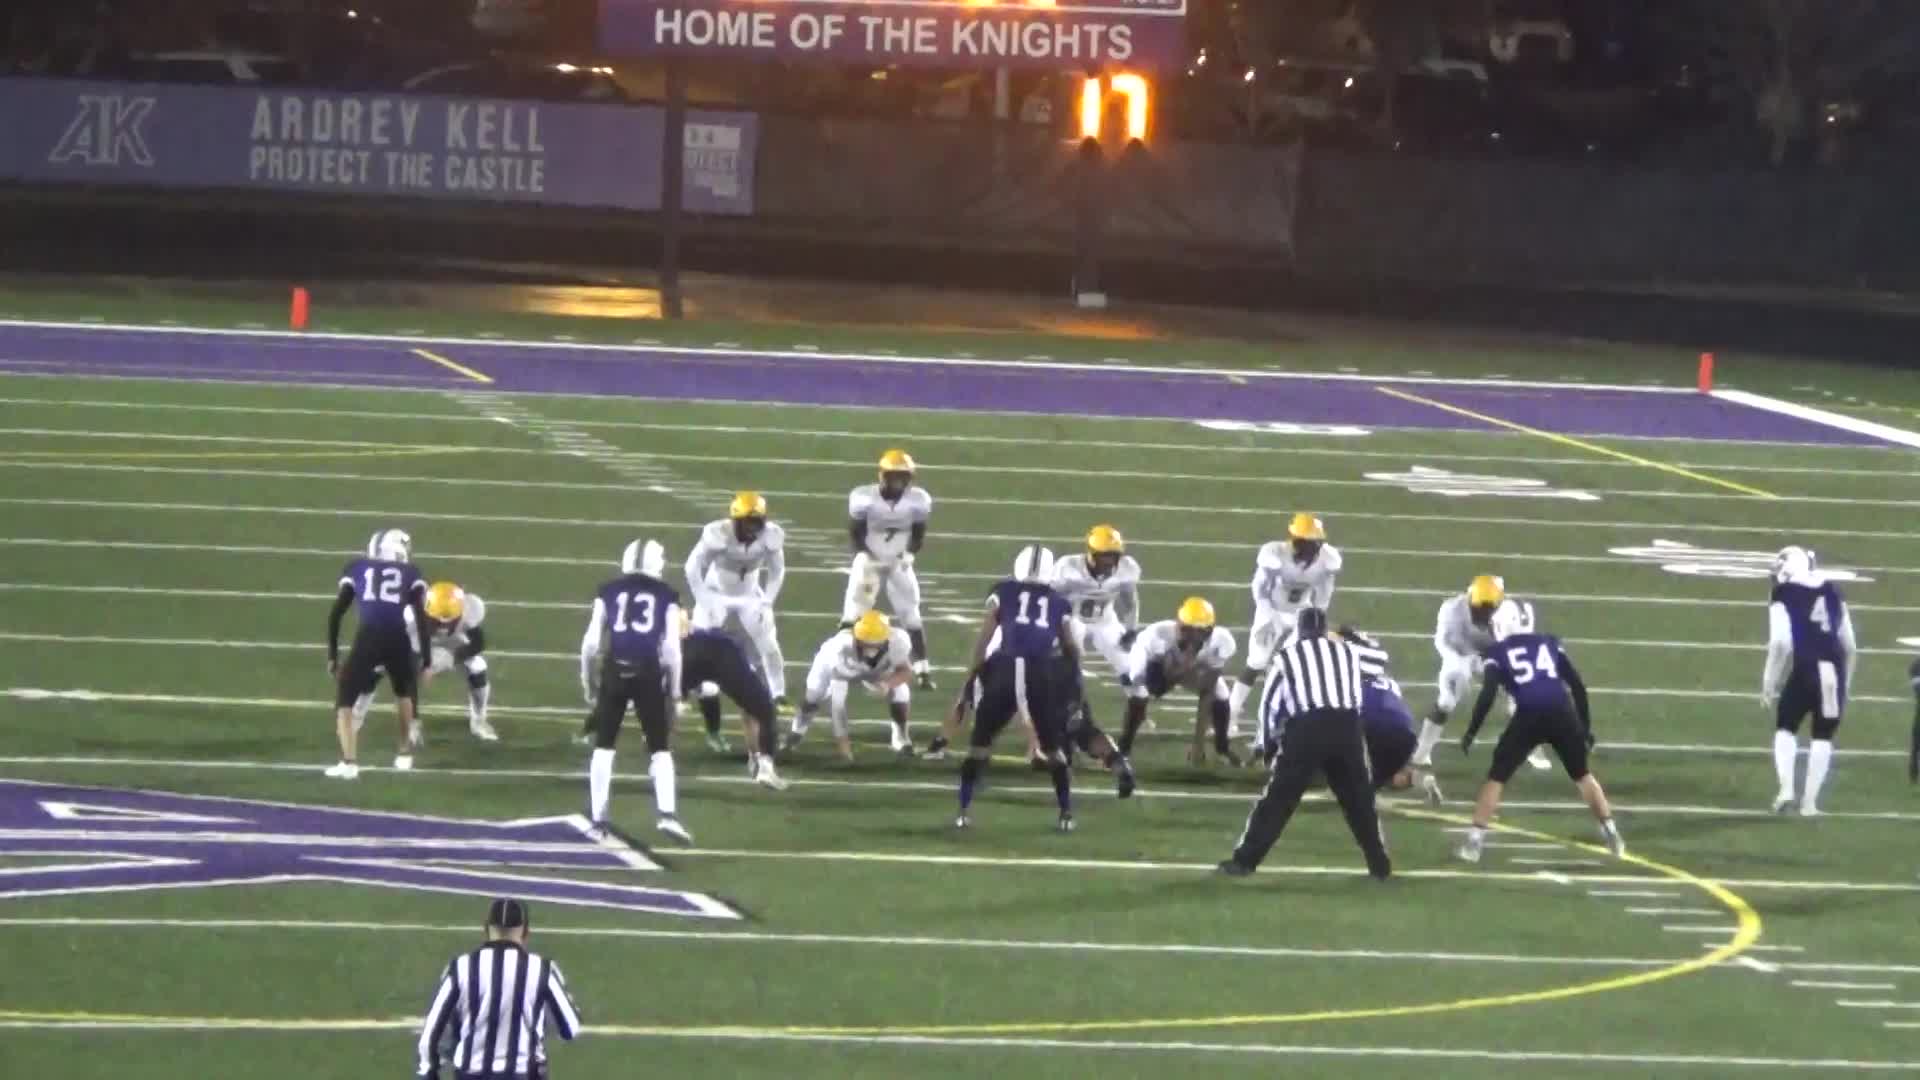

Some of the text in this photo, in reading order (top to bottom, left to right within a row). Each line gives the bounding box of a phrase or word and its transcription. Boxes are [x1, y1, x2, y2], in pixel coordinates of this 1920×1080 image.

[655, 9, 1133, 59] HOME OF THE KNIGHTS
[251, 96, 545, 152] ARDREY KELL
[1083, 73, 1148, 138] 17
[48, 96, 157, 165] AK
[250, 146, 544, 193] PROTECT THE CASTLE
[361, 567, 403, 604] 12
[612, 591, 657, 634] 13
[1015, 591, 1049, 628] 11
[1810, 596, 1831, 631] 4
[1507, 644, 1558, 684] 54
